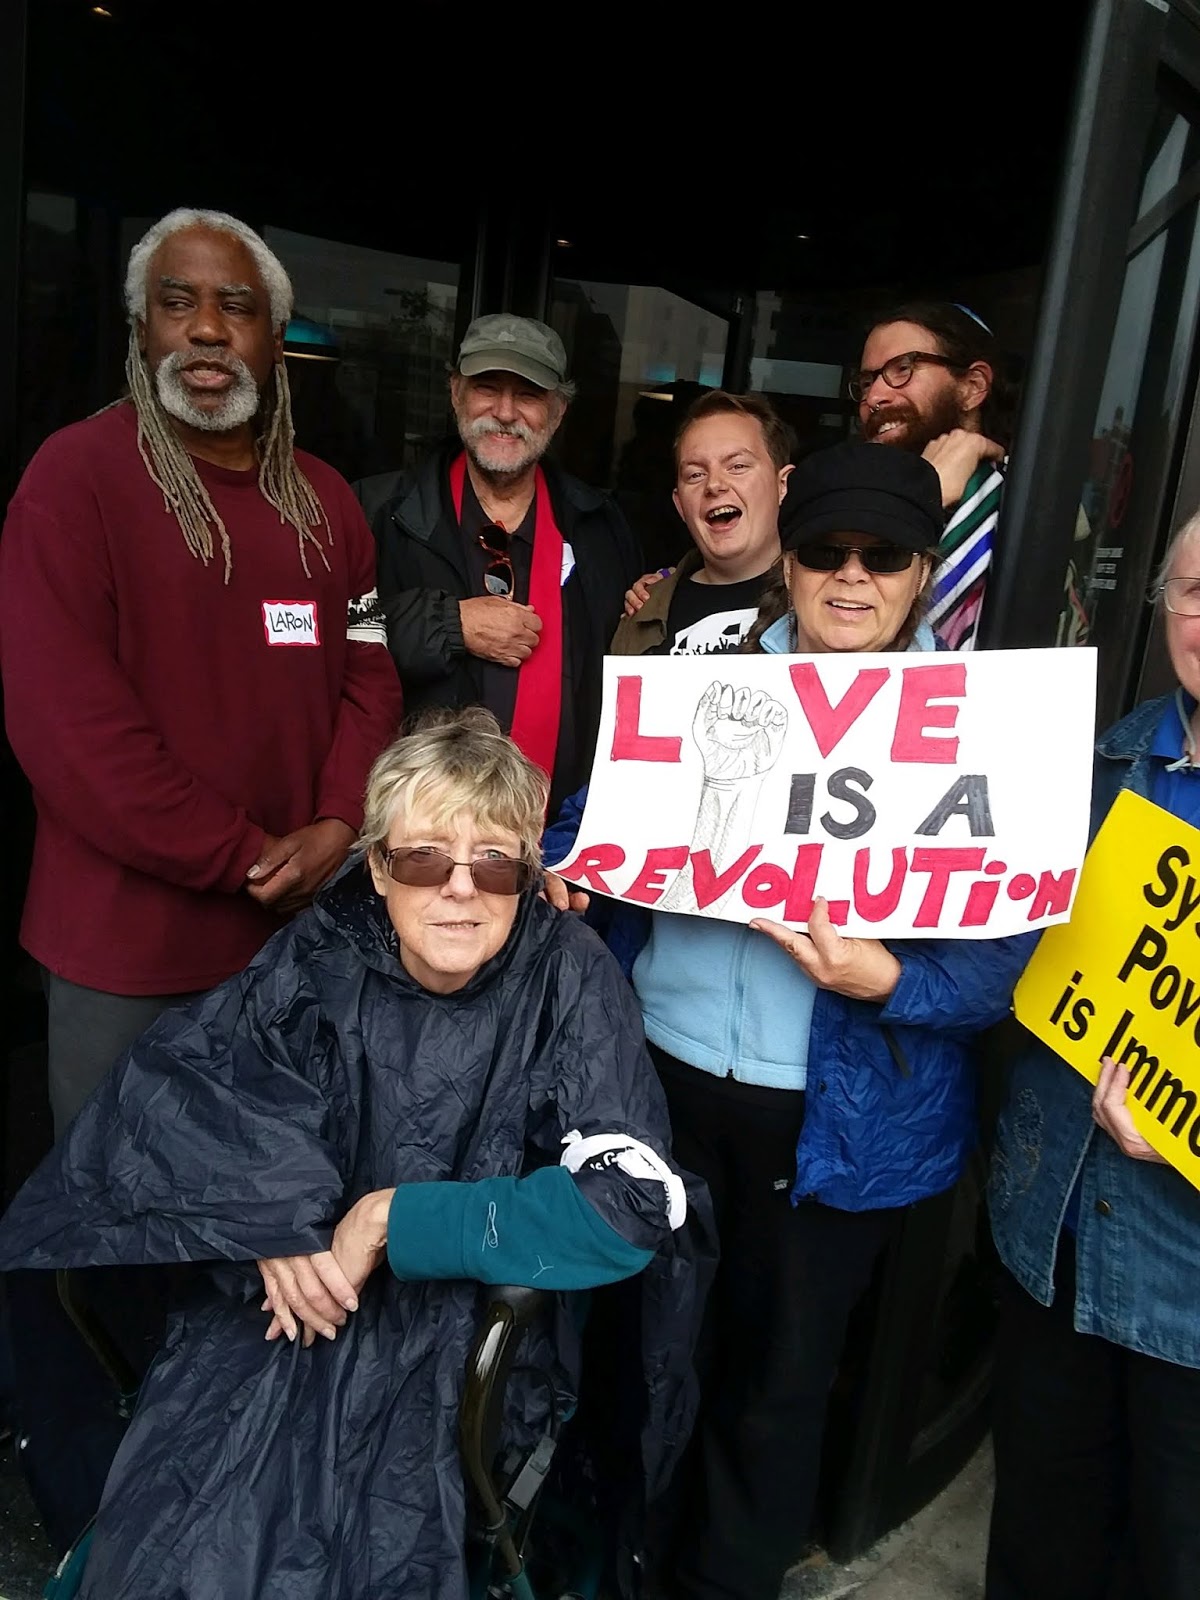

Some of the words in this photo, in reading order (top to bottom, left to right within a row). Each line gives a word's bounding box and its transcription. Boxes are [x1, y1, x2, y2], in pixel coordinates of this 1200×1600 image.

[269, 611, 313, 632] LARON
[784, 766, 877, 840] IS
[914, 775, 996, 838] A
[1050, 970, 1095, 1041] is
[1117, 924, 1200, 1048] Pov
